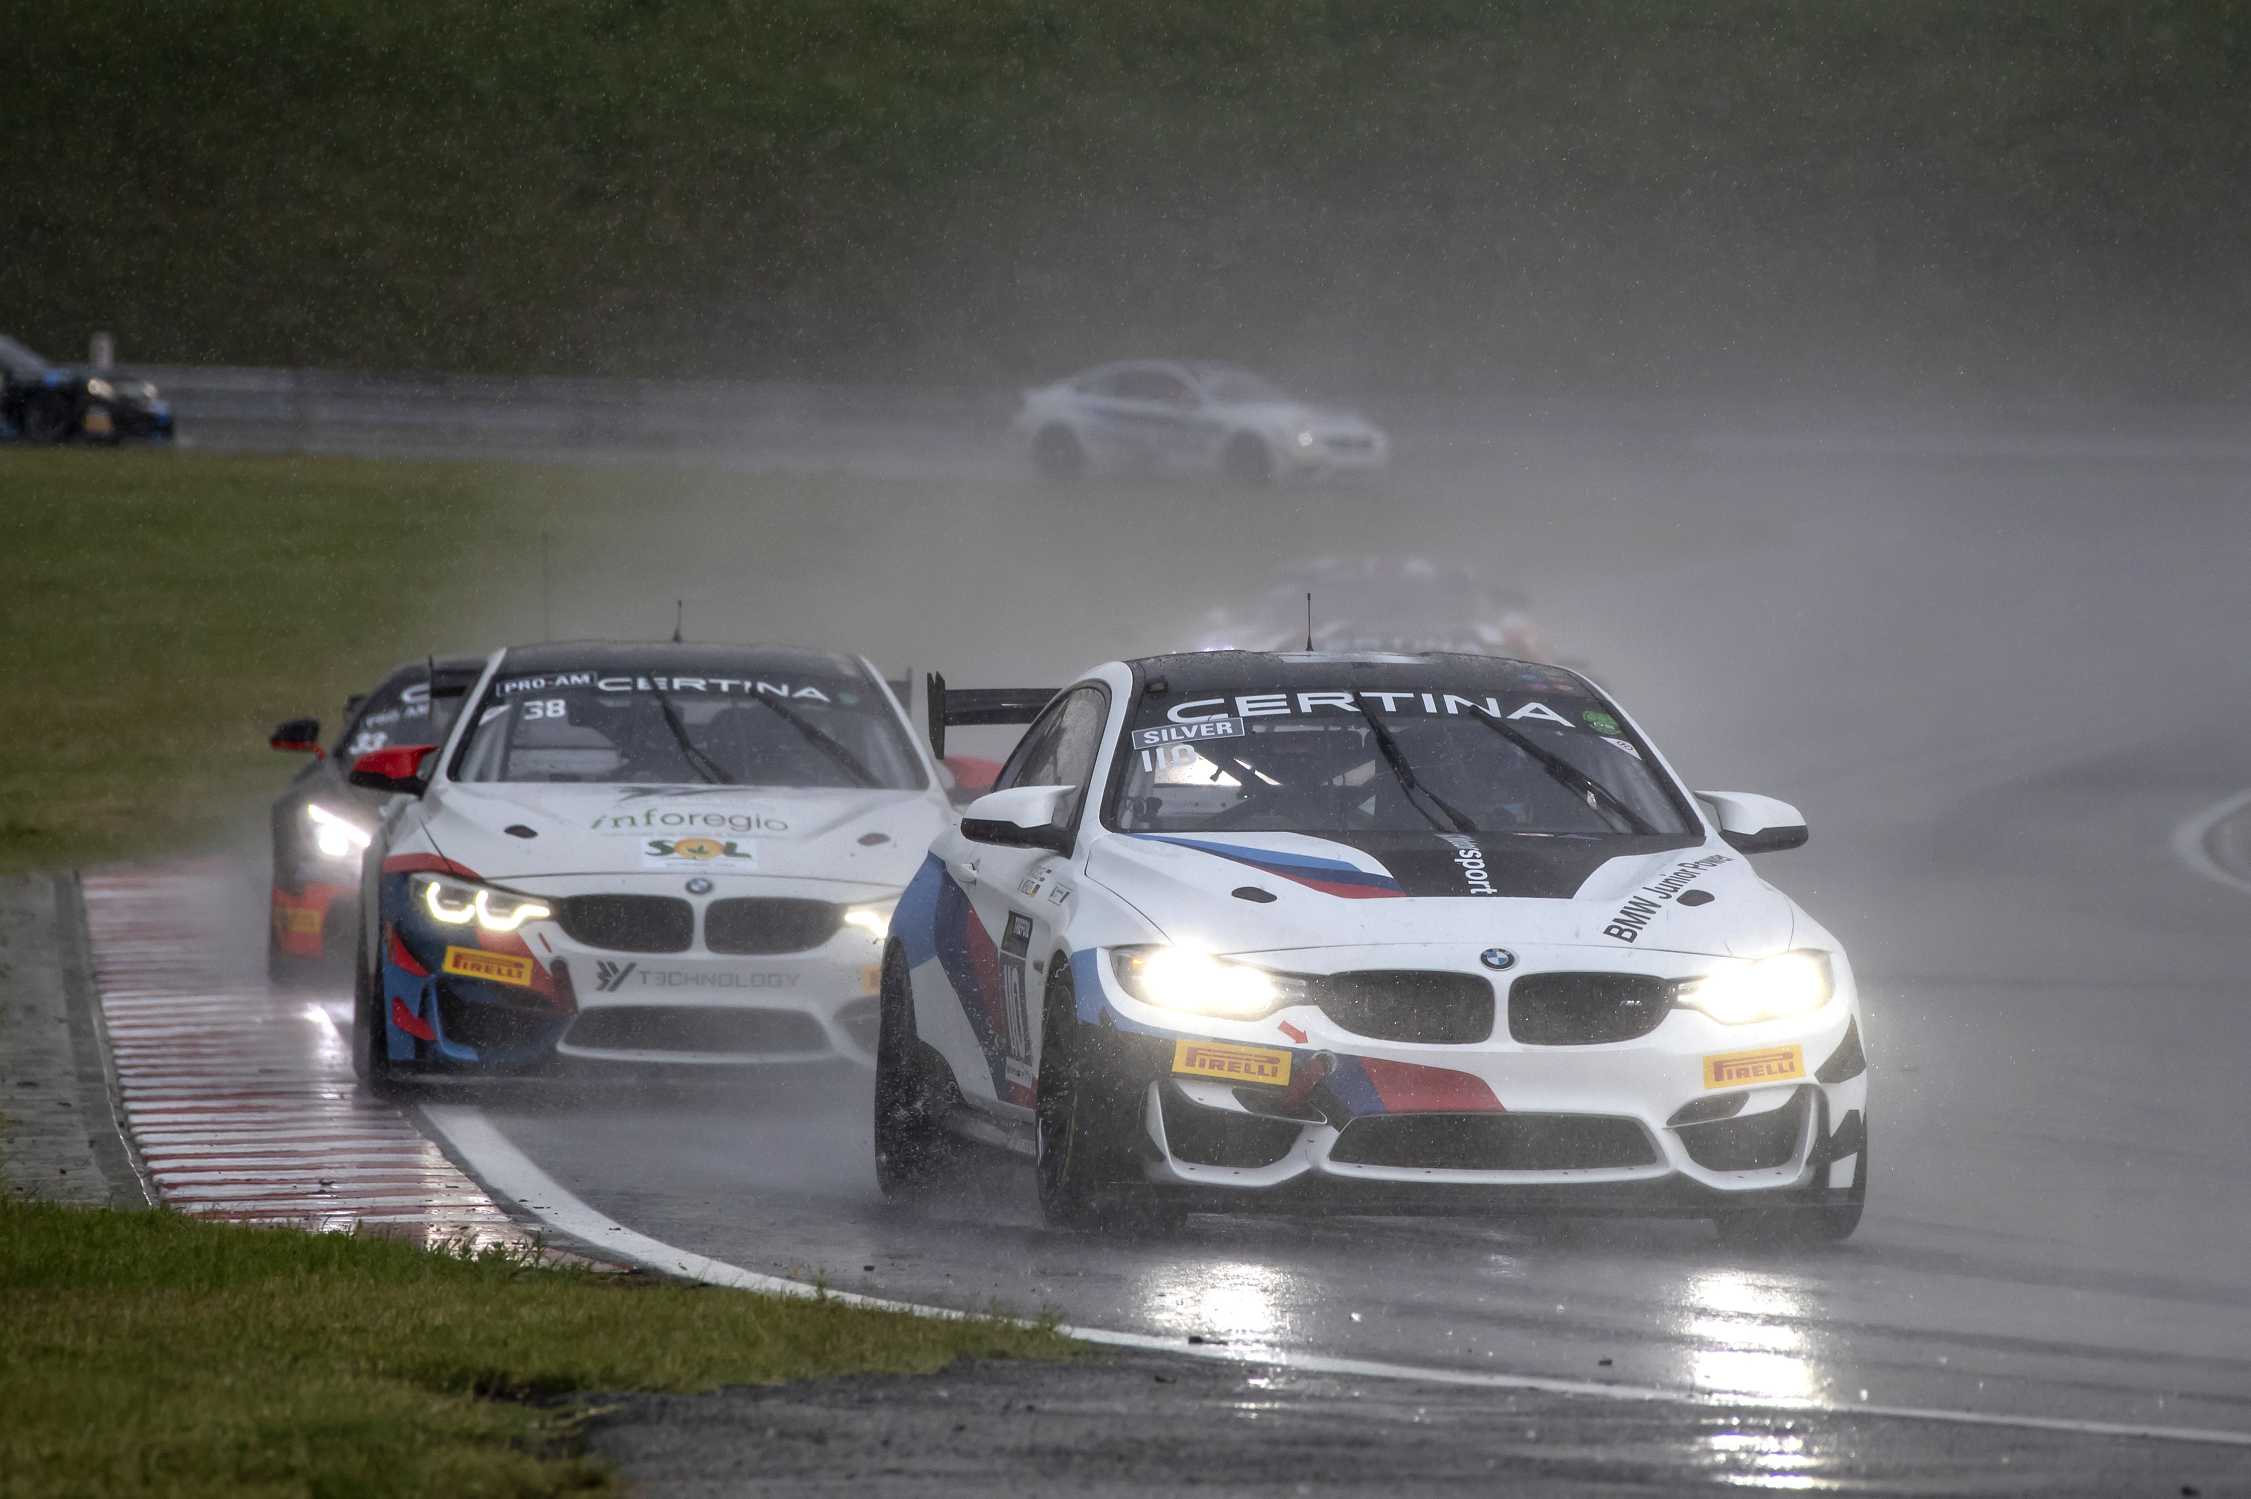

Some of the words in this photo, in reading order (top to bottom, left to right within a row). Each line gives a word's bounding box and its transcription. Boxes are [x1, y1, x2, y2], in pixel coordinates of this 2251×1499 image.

[504, 673, 590, 693] PRO-AM
[598, 677, 831, 703] CERTINA
[523, 698, 567, 720] 38
[1166, 692, 1576, 729] CERTINA
[1143, 720, 1233, 745] SILVER
[1603, 895, 1662, 944] BMW
[1642, 868, 1701, 899] Junior
[452, 953, 524, 979] PIRELLI
[1184, 1047, 1280, 1077] PIRELLI
[1713, 1051, 1795, 1082] PIRELLI
